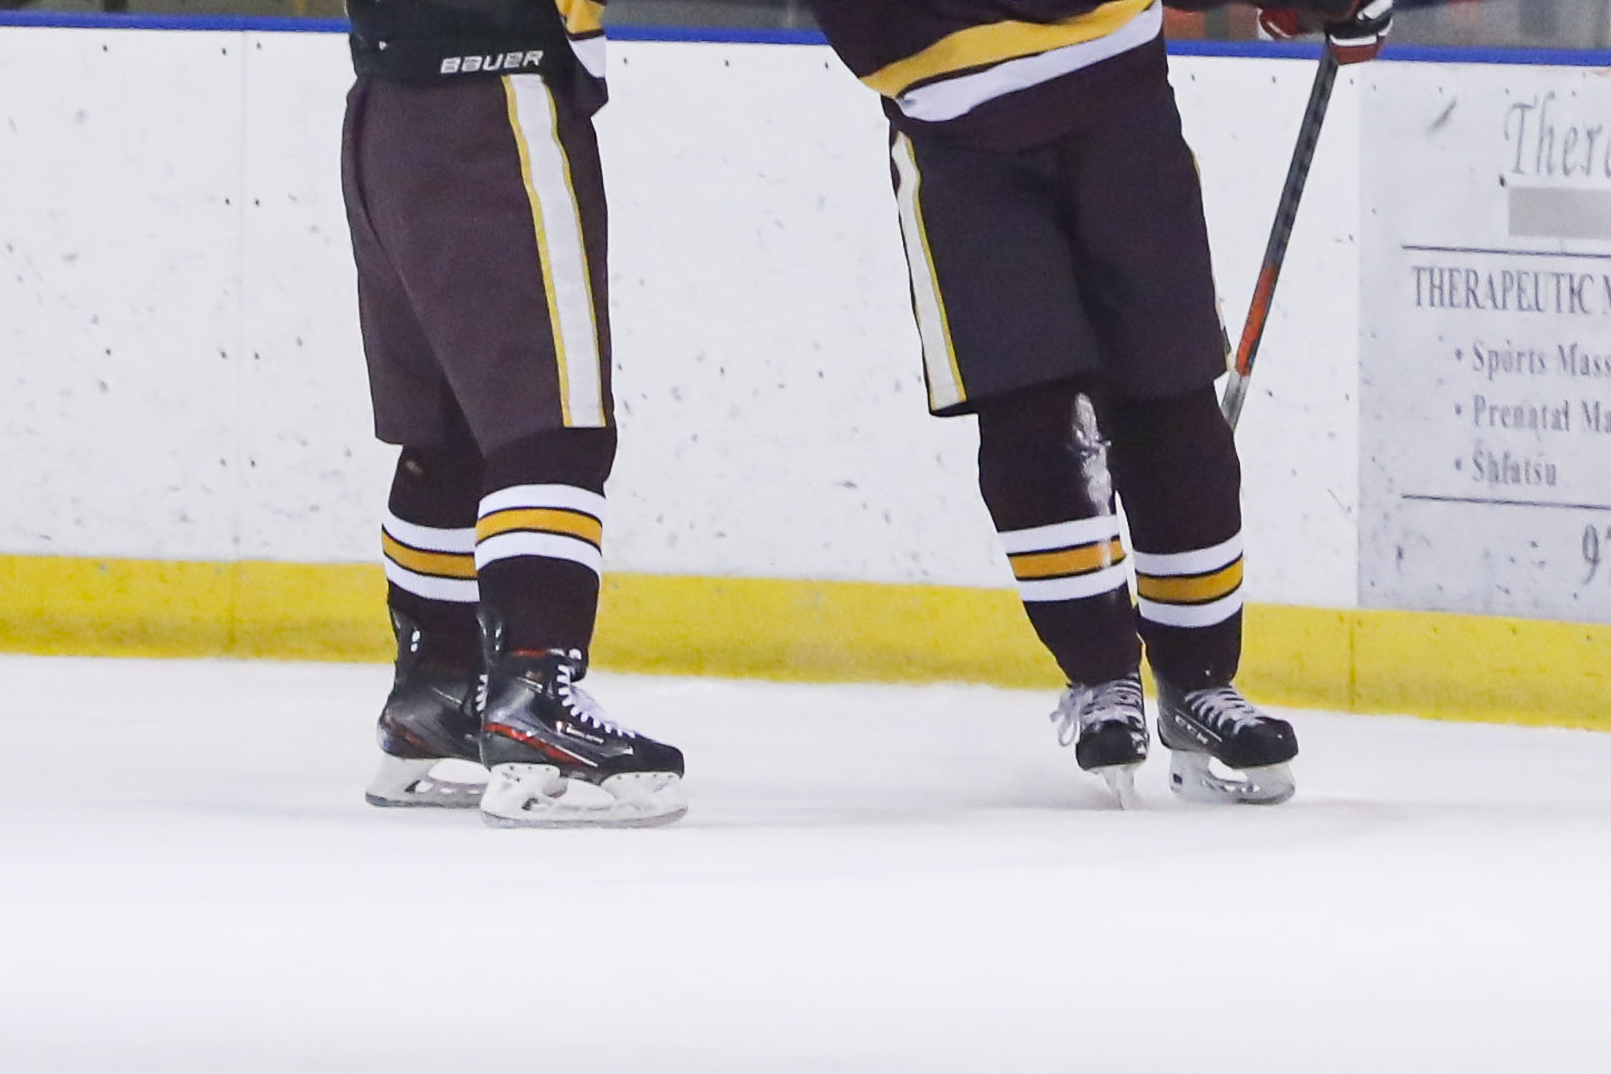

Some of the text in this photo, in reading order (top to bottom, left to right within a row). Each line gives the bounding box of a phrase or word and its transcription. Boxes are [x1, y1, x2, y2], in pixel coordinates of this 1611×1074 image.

[440, 50, 544, 74] BAUER
[1411, 265, 1595, 316] THERAPEUTIC
[1472, 339, 1547, 381] Sports
[1473, 394, 1571, 432] Prenatal
